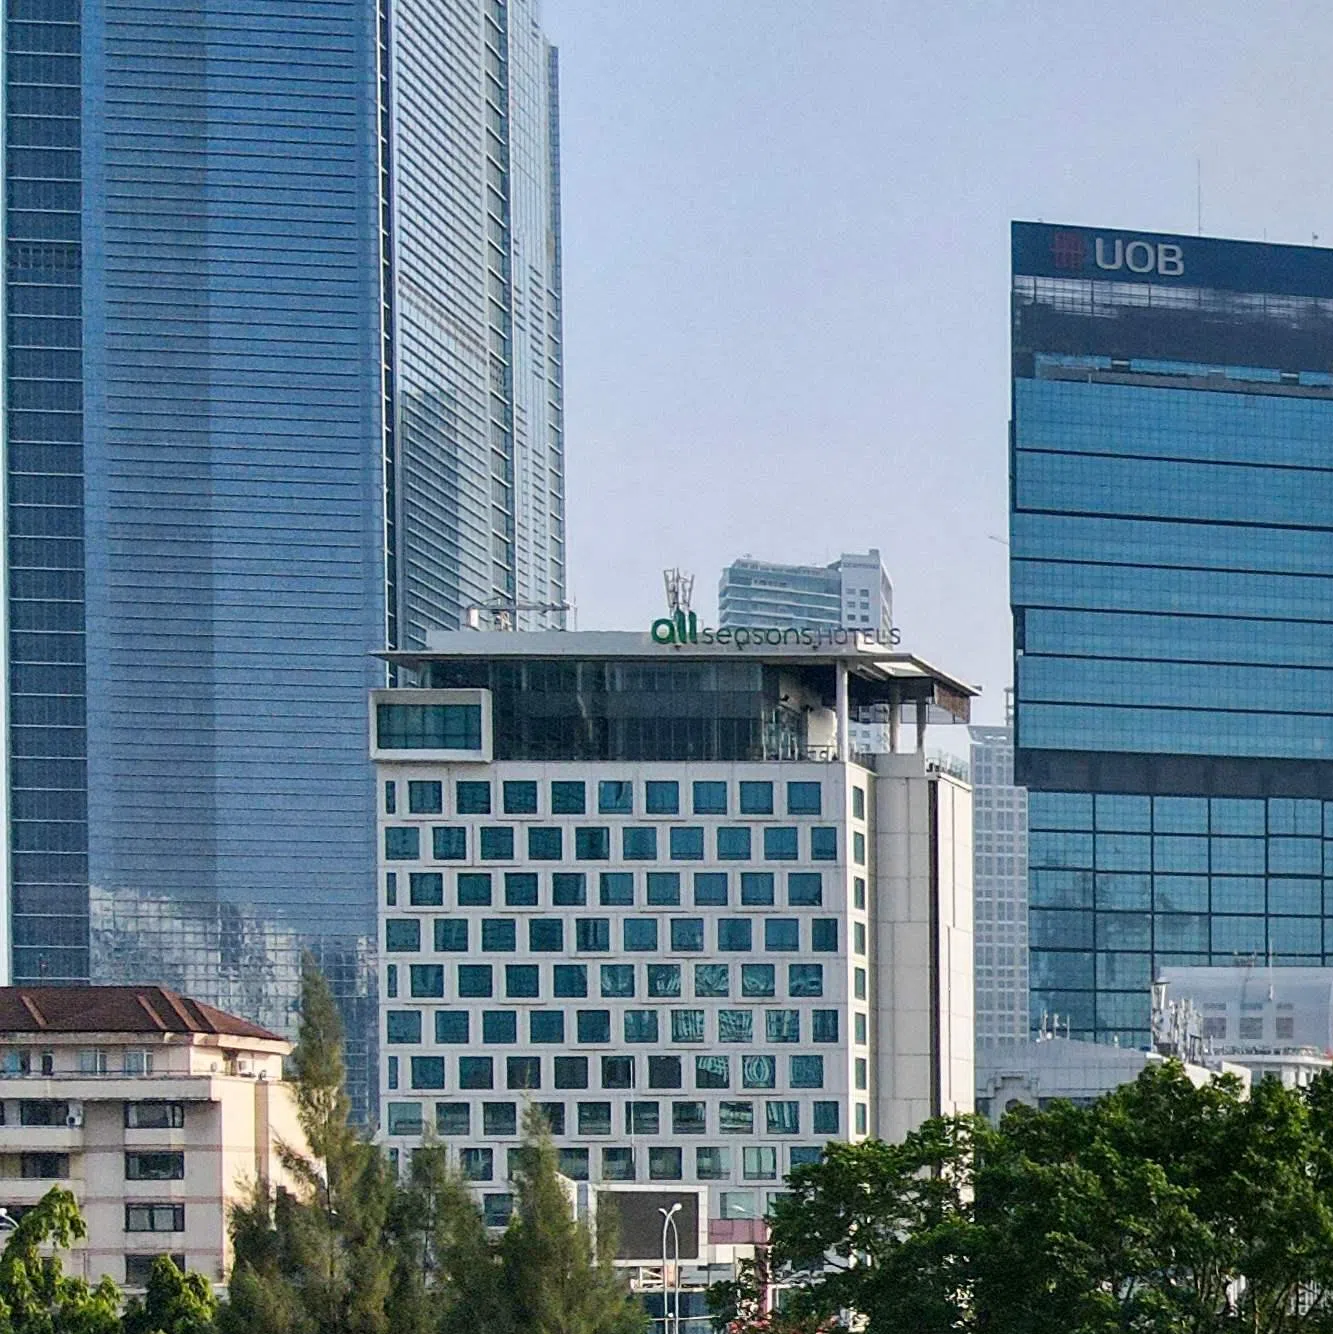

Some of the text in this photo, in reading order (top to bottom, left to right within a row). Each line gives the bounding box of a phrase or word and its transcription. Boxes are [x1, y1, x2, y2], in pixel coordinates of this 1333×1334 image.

[1095, 237, 1185, 276] UOB
[651, 607, 698, 645] all
[818, 627, 901, 645] HOTELS
